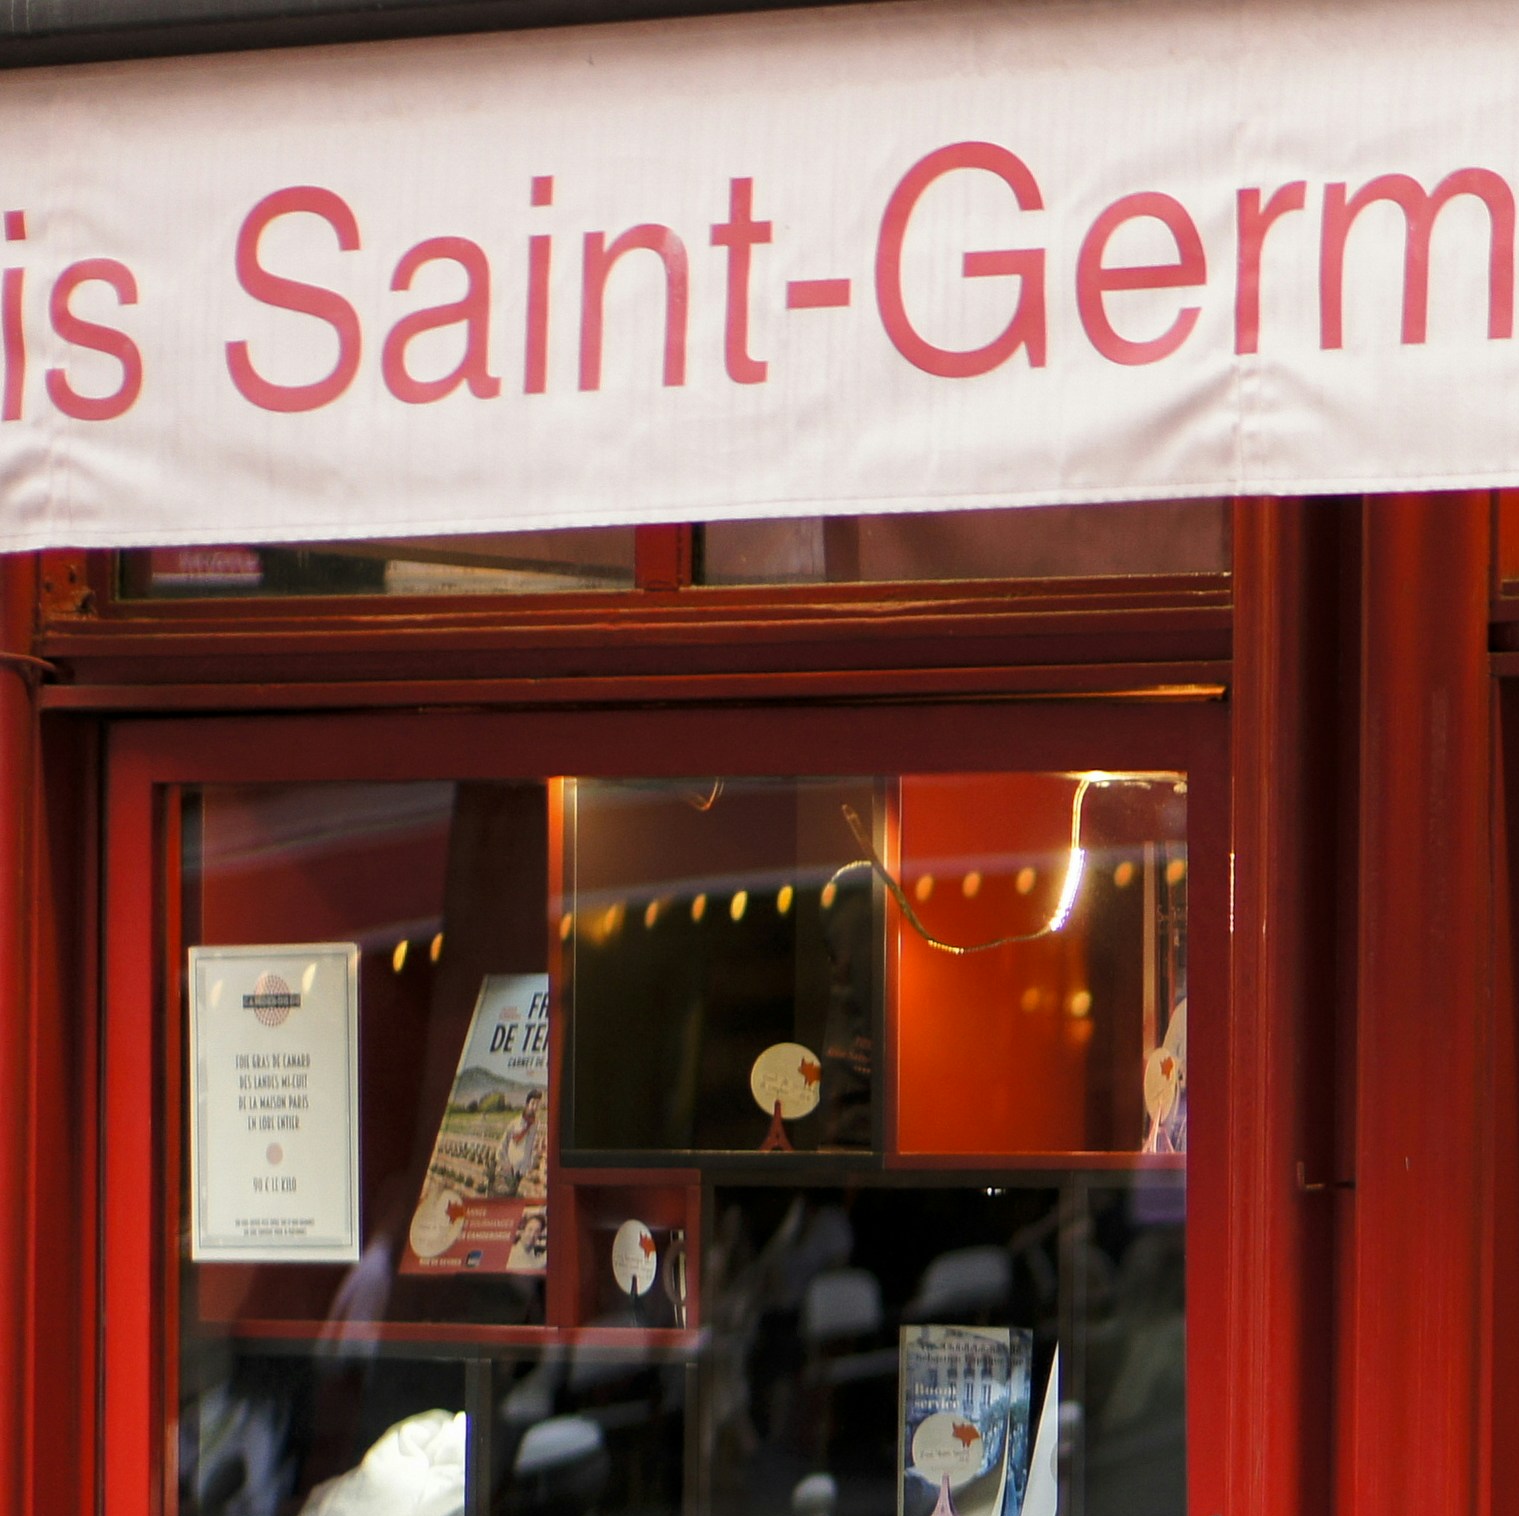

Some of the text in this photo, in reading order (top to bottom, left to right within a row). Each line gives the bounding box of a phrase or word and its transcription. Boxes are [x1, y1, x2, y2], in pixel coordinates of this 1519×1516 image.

[490, 1024, 518, 1052] DE
[252, 1054, 270, 1069] GRAS
[272, 1053, 280, 1068] DE
[283, 1053, 311, 1069] CANARD
[239, 1075, 251, 1090] DES
[254, 1074, 279, 1090] LANDES
[249, 1095, 257, 1110] LA
[260, 1094, 286, 1110] MAISON
[281, 1175, 297, 1191] KILO
[914, 1381, 957, 1397] Room
[914, 1399, 958, 1410] service
